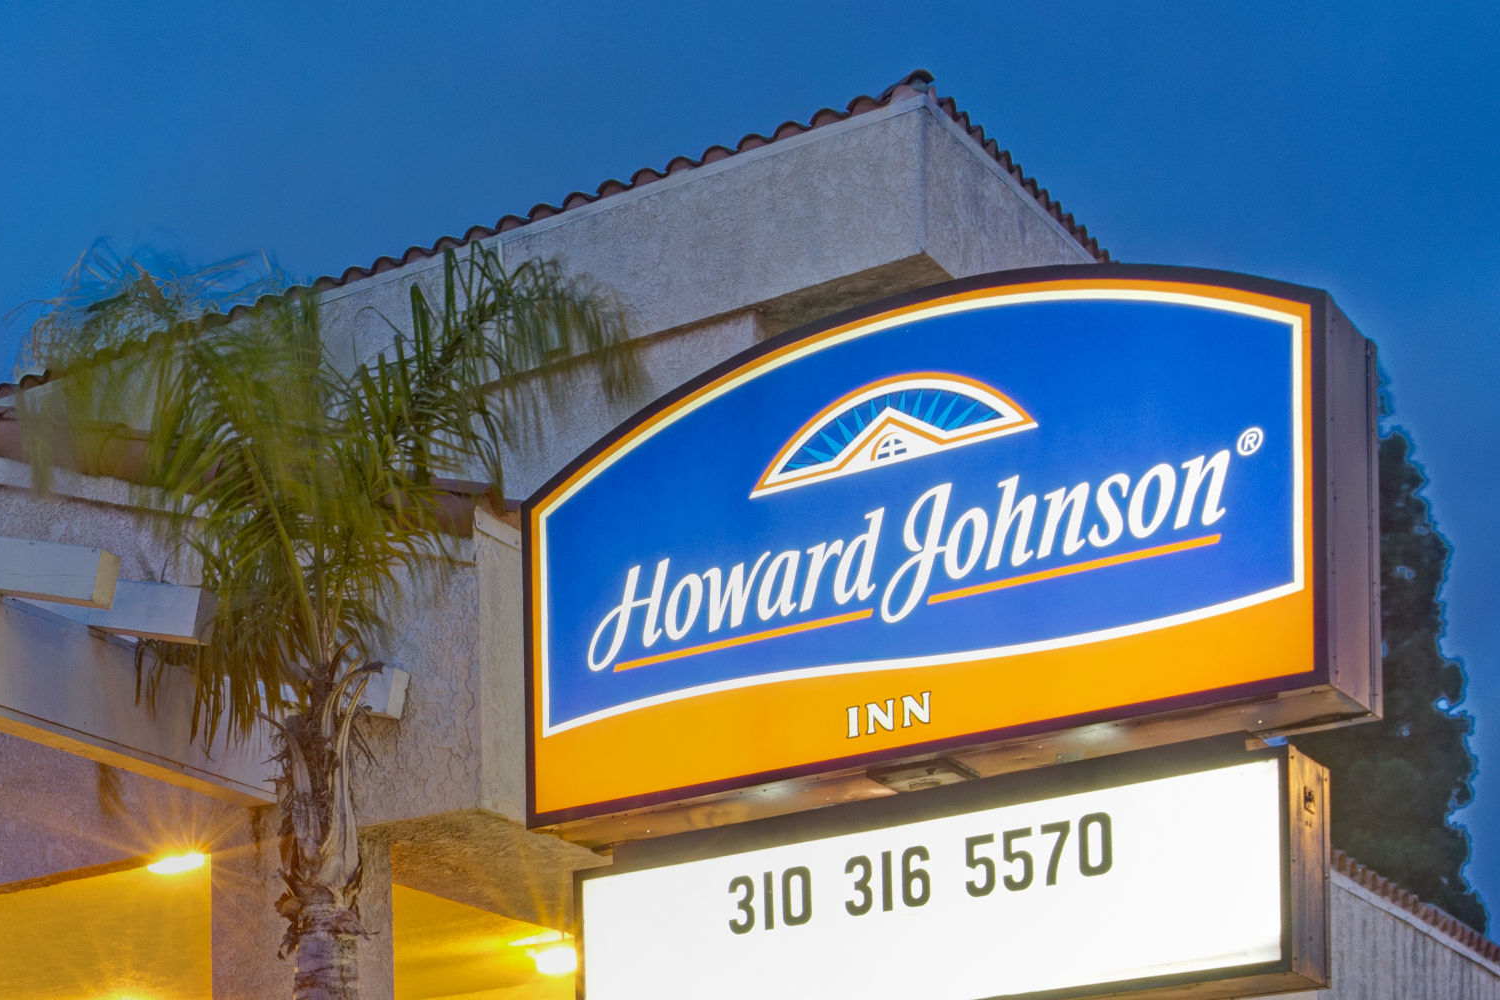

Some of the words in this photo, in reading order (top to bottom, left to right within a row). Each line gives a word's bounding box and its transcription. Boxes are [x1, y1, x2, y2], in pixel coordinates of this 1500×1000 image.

[586, 506, 885, 673] Howard
[846, 691, 932, 739] INN
[728, 865, 812, 935] 310
[844, 845, 931, 918] 316
[965, 811, 1114, 898] 5570
